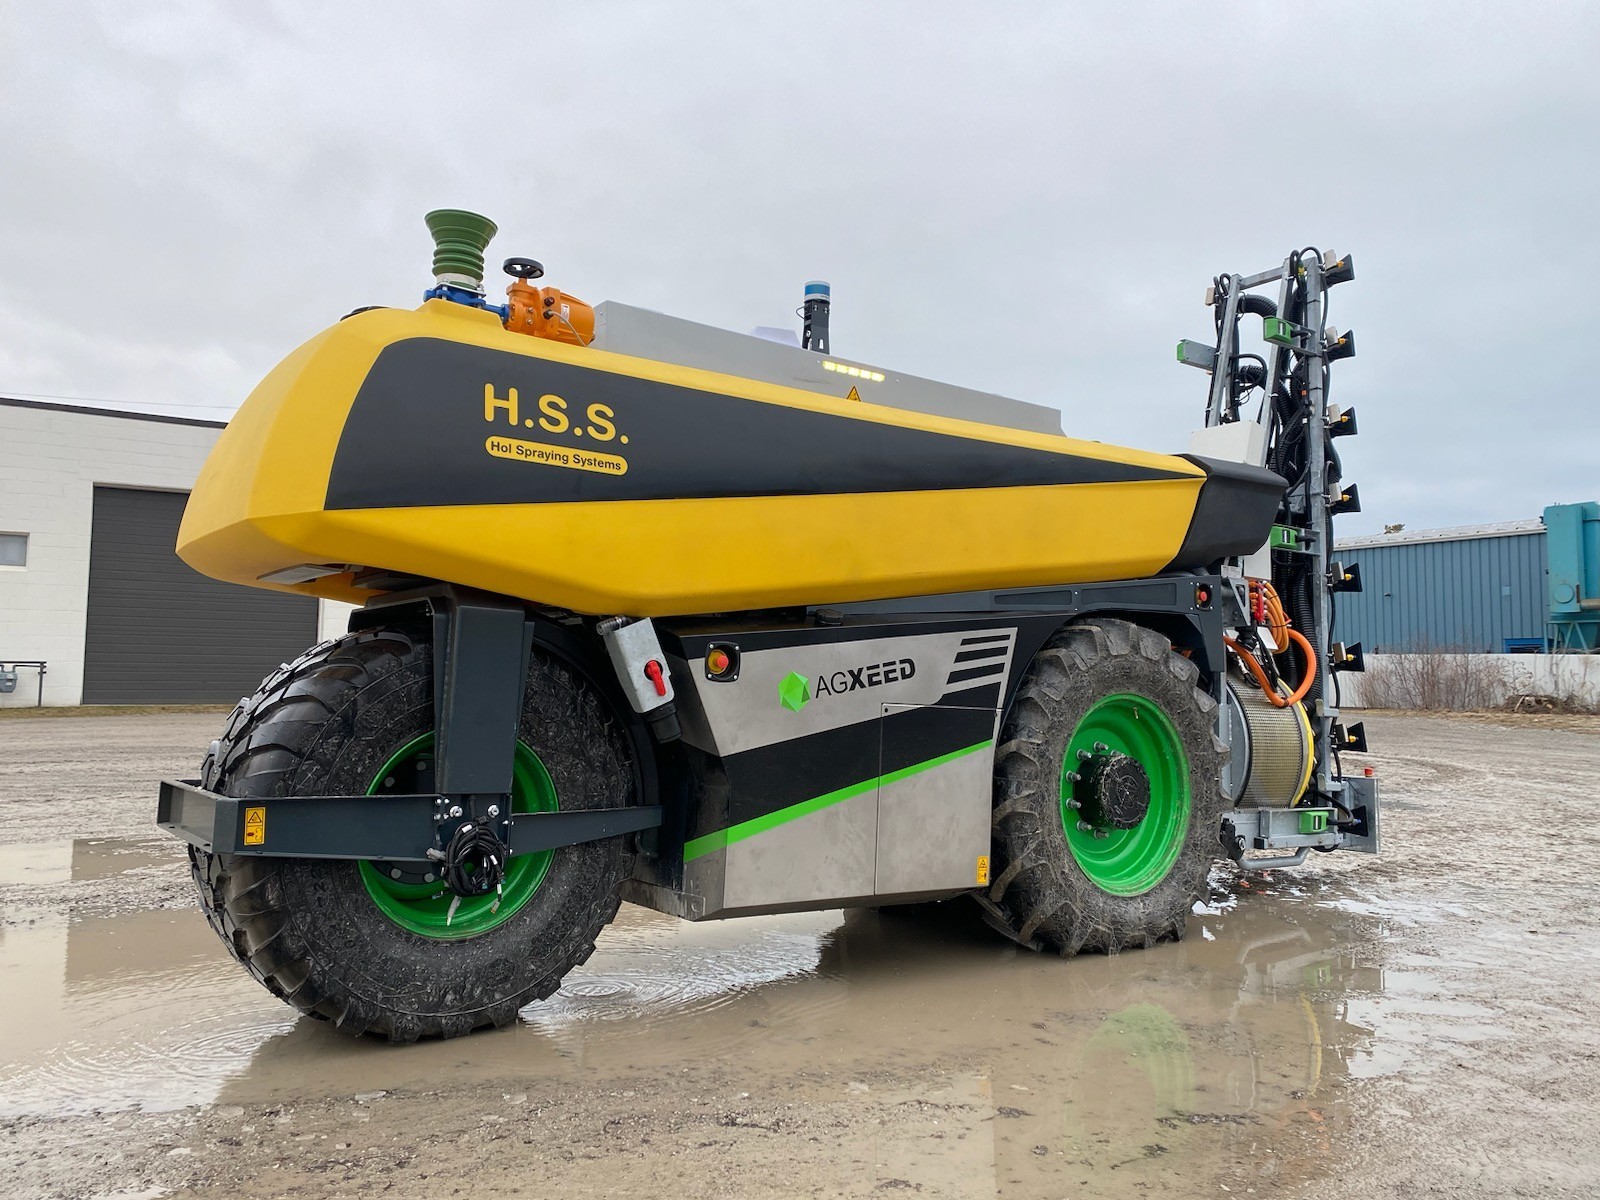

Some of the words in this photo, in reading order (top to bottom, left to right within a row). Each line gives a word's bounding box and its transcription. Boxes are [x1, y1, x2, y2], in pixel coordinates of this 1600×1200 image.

[484, 383, 629, 444] H.S.S.
[491, 440, 512, 454] Hol
[516, 444, 569, 465] Spraying
[573, 453, 621, 471] Systems
[815, 658, 916, 699] AGXEED
